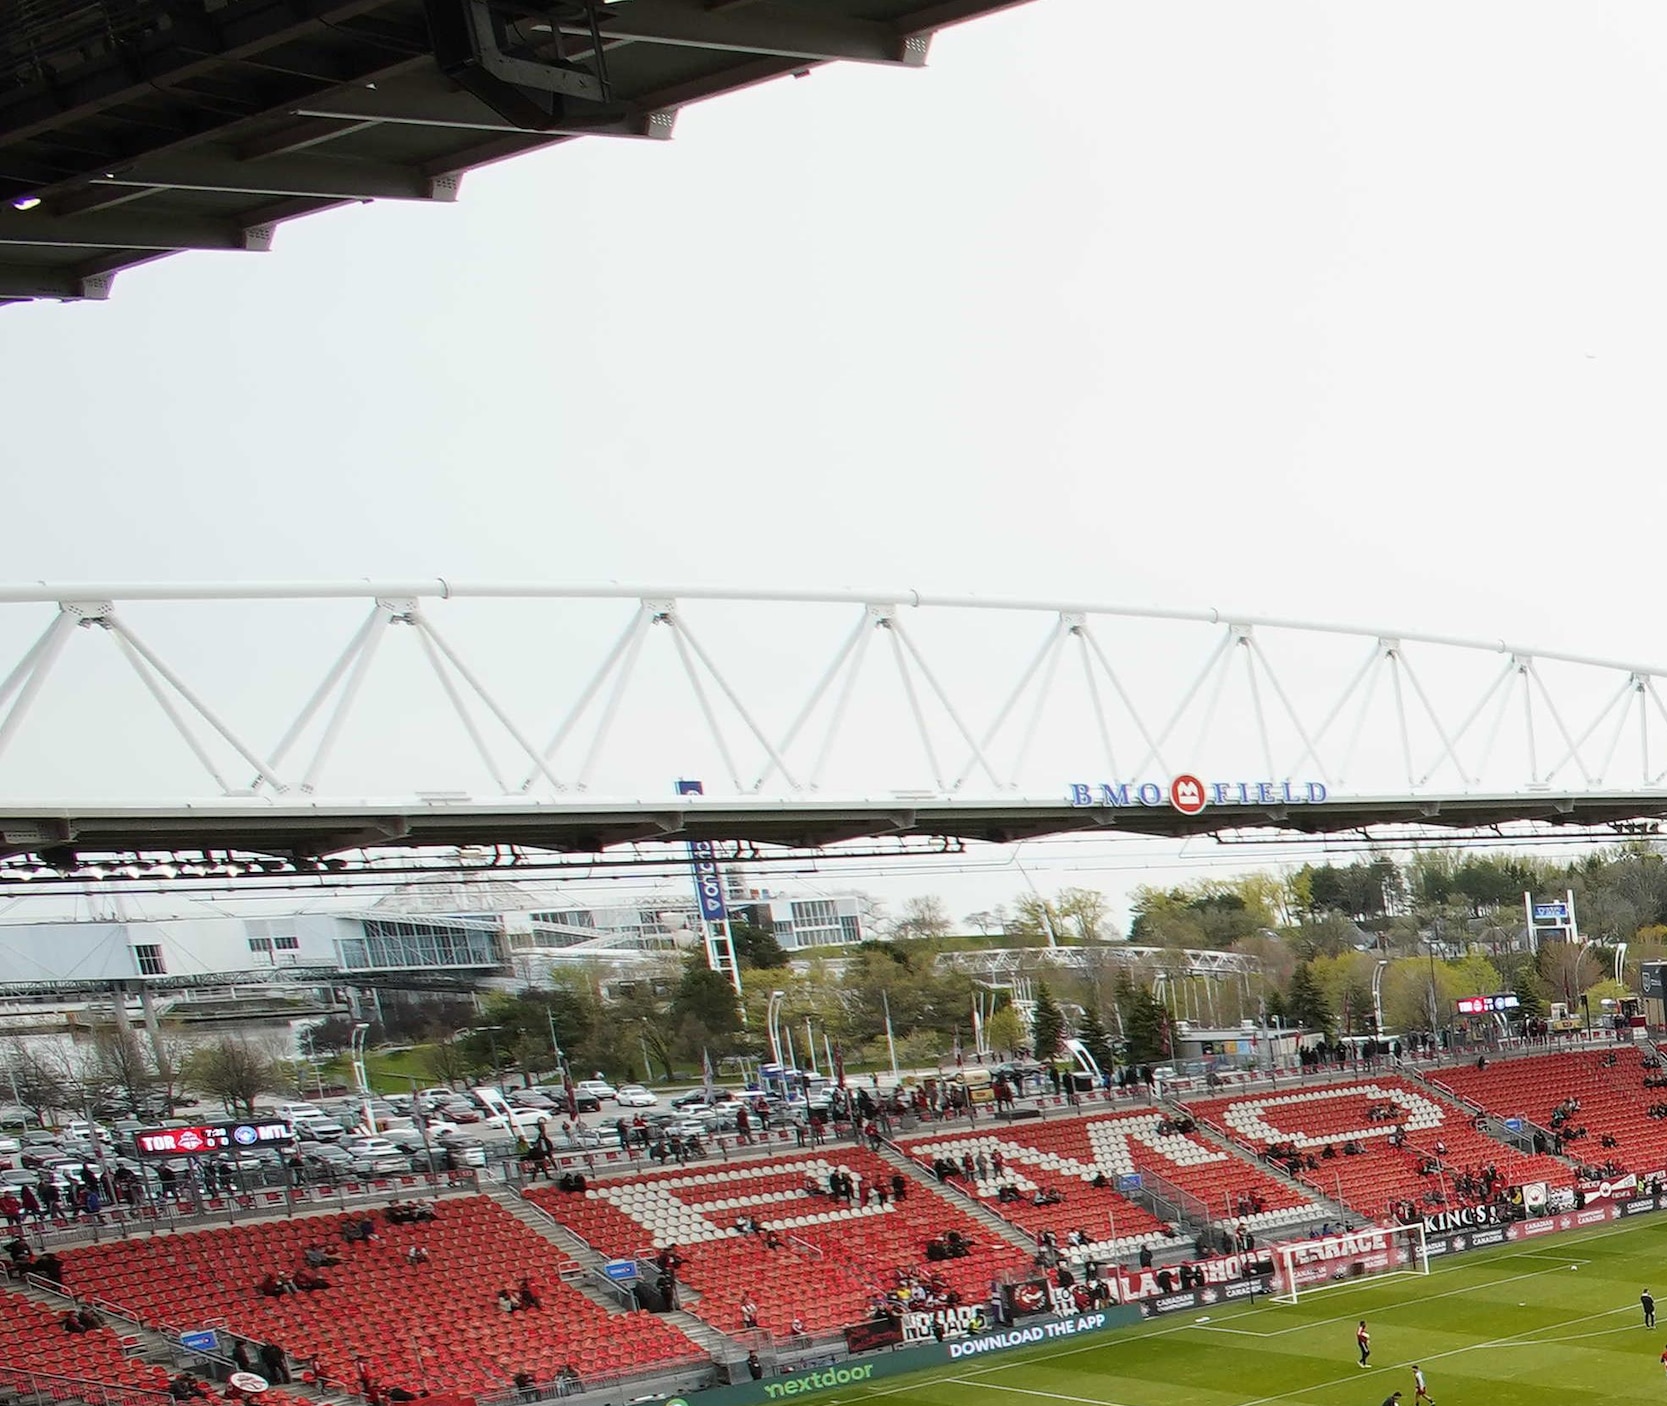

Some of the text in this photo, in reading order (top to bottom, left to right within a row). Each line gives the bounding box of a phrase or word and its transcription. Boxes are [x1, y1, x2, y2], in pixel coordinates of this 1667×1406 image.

[1071, 781, 1327, 806] BMO FIELD
[142, 1136, 176, 1151] TOR
[258, 1124, 293, 1140] MTL
[950, 1314, 1105, 1358] DOWNLOAD THE APP
[764, 1364, 874, 1398] nextdoor
